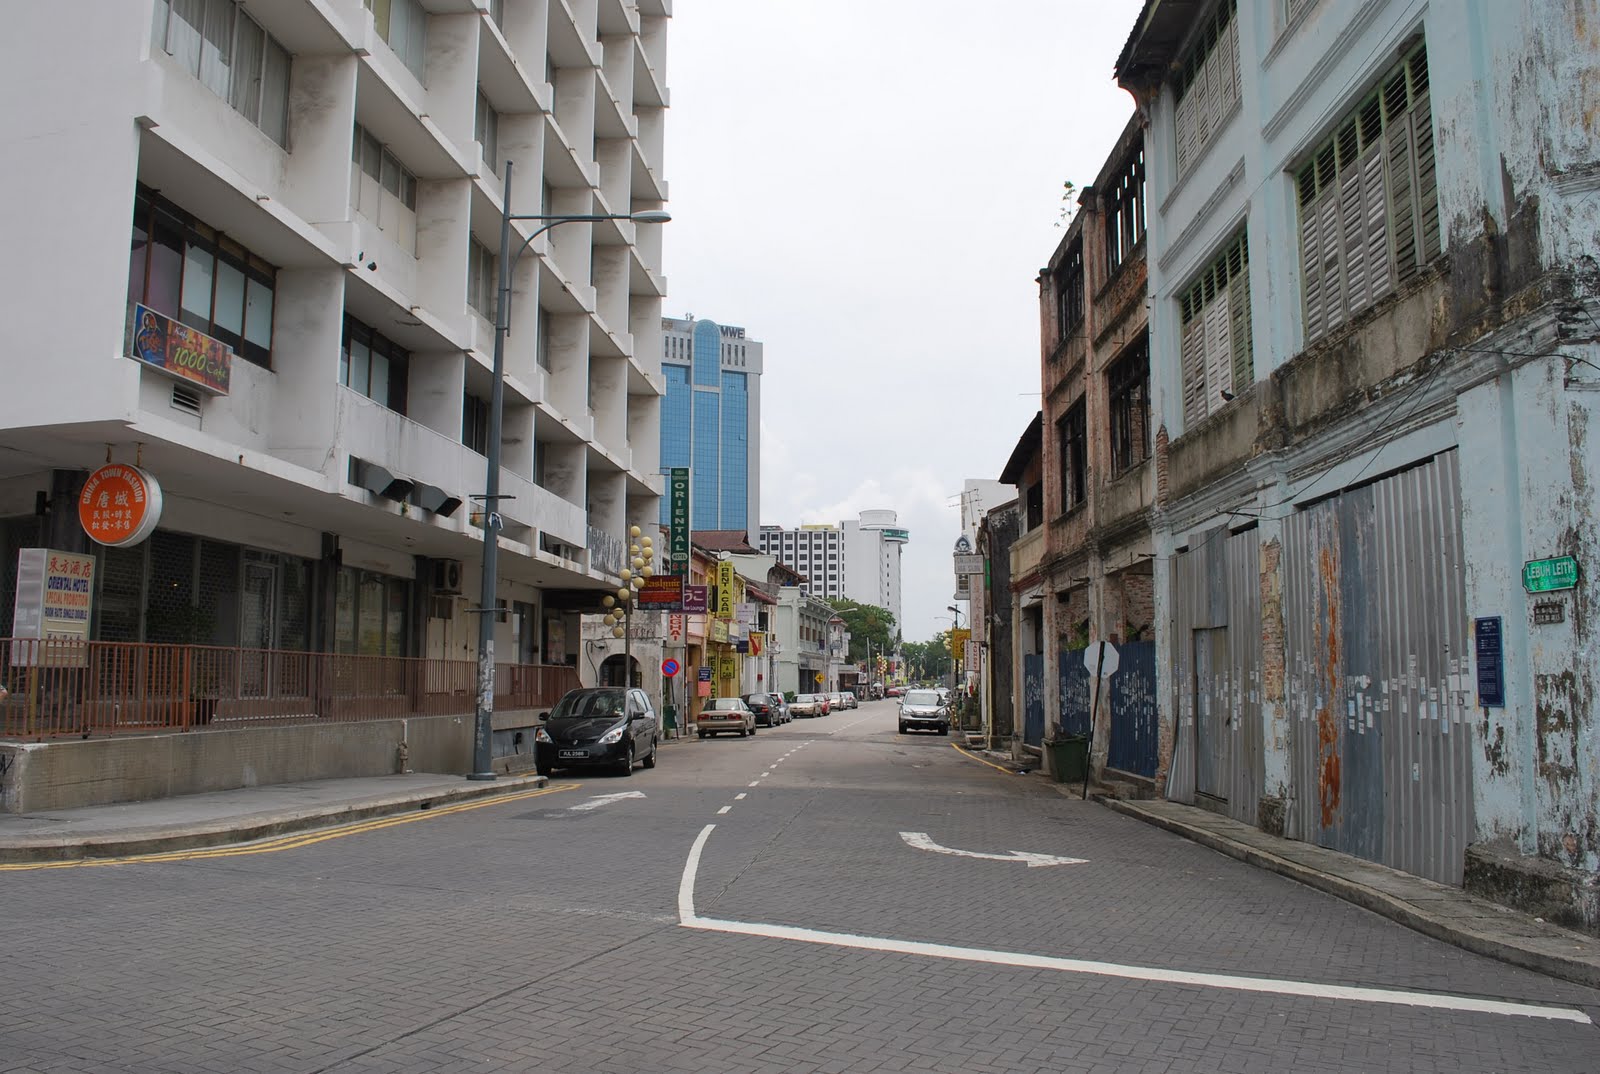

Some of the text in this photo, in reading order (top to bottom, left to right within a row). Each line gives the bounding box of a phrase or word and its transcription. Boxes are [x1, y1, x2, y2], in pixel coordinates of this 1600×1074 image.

[721, 326, 745, 339] MWE
[174, 347, 206, 370] 1000
[83, 468, 144, 504] CHINA TOWN FASHION
[674, 482, 685, 551] ORIENTAL
[721, 568, 729, 587] RENT
[1526, 561, 1574, 579] LEBUH LEITH
[48, 576, 89, 593] ORIENTAL HOTEL
[721, 597, 729, 612] CAR
